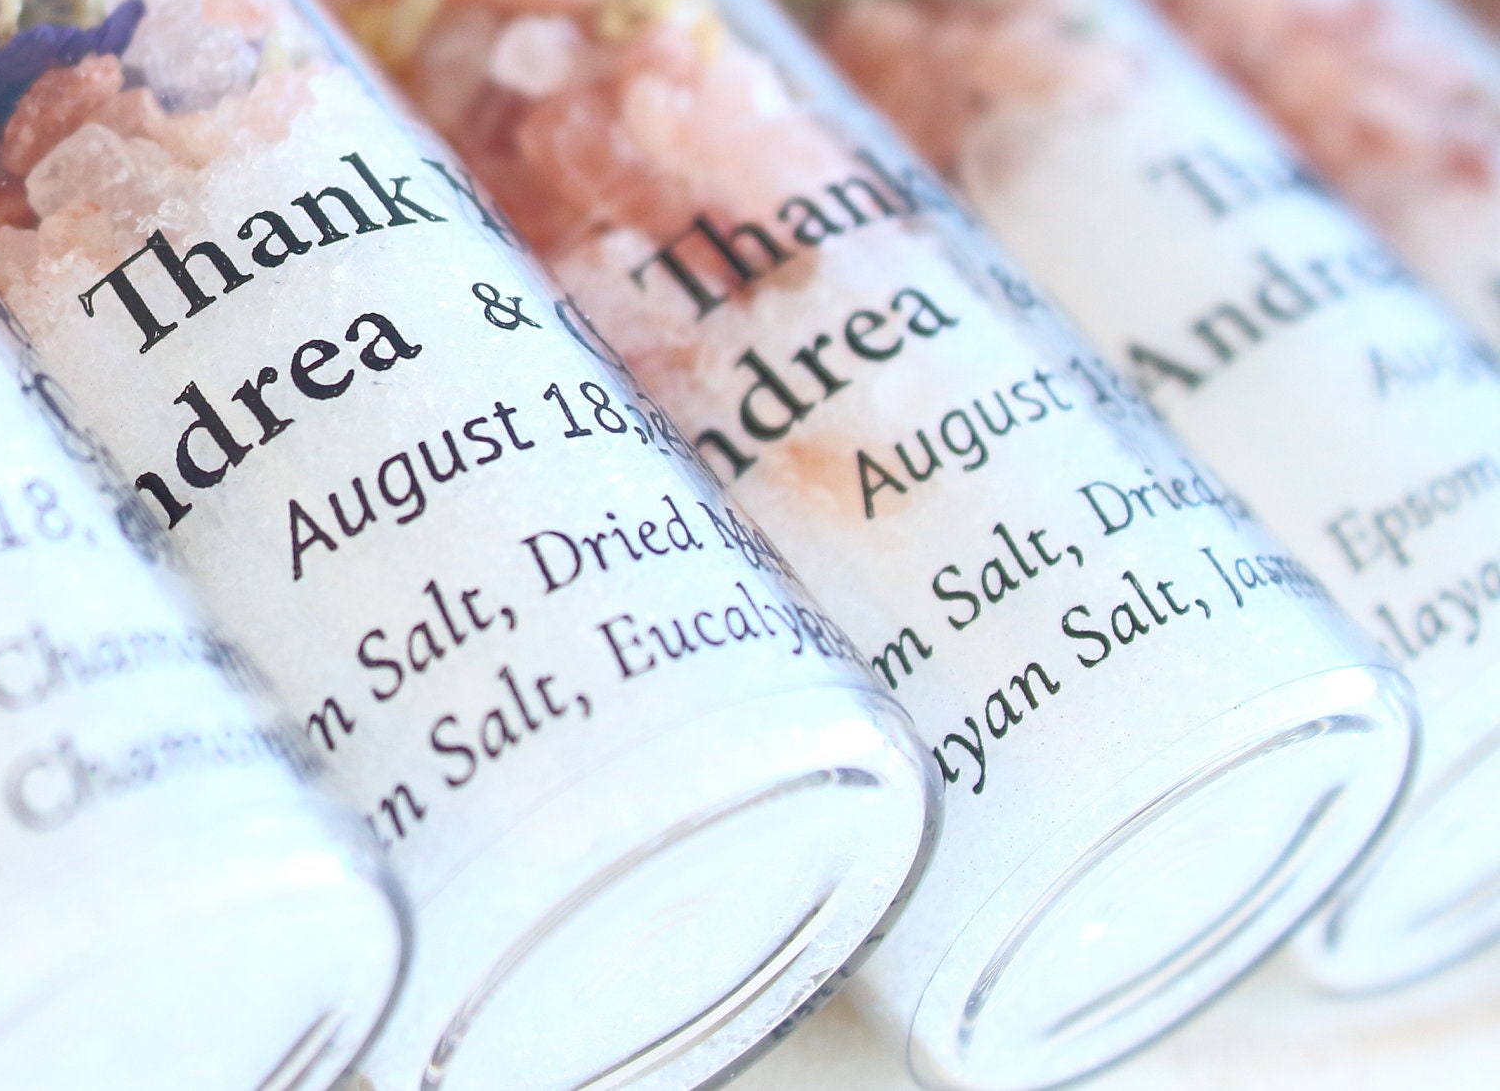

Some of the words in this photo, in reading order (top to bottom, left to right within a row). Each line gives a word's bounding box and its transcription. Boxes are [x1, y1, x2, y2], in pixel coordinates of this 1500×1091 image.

[79, 152, 448, 354] Thank
[134, 311, 423, 532] ndrea
[471, 281, 543, 332] &
[287, 400, 536, 581] August
[542, 381, 649, 445] 18,
[692, 285, 960, 481] ndrea
[853, 368, 1074, 520] August
[356, 579, 518, 703] Salt,
[520, 494, 704, 596] Dried
[932, 521, 1085, 632] Salt,
[1060, 569, 1211, 668] Salt,
[429, 666, 592, 788] Salt,
